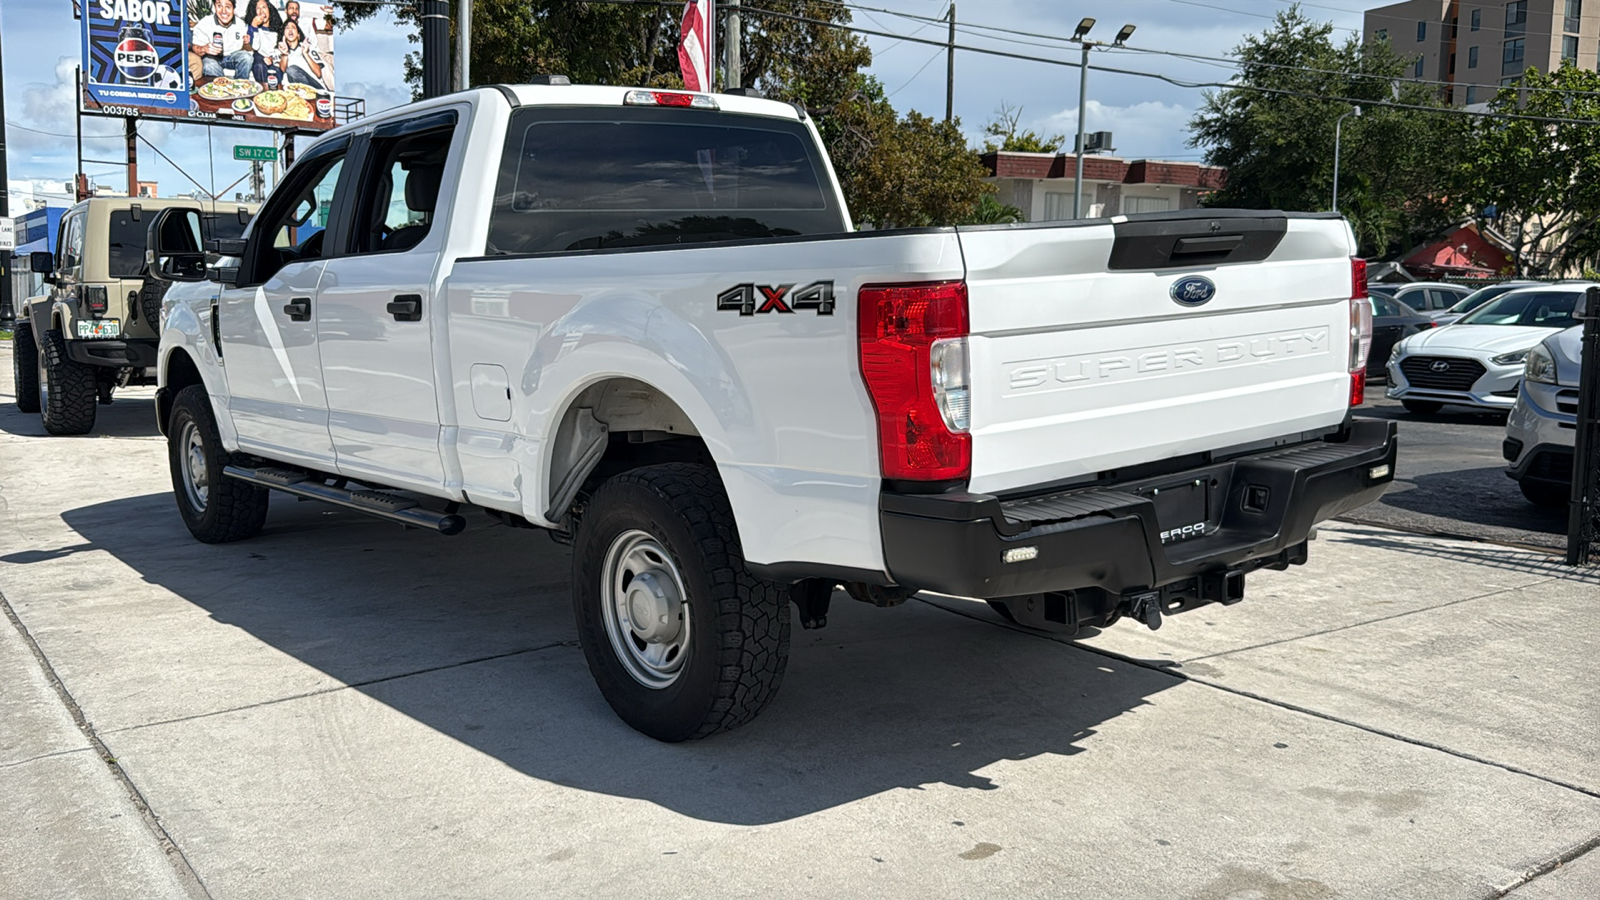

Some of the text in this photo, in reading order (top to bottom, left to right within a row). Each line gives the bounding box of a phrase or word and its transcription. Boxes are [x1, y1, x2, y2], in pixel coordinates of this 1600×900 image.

[100, 0, 171, 25] SABOR
[117, 53, 156, 65] PEPSI
[103, 105, 139, 117] 003785
[239, 148, 275, 158] SW 17 Ct
[1183, 281, 1209, 300] Ford
[79, 324, 94, 335] PP4
[1009, 330, 1326, 390] SUPER DUTY
